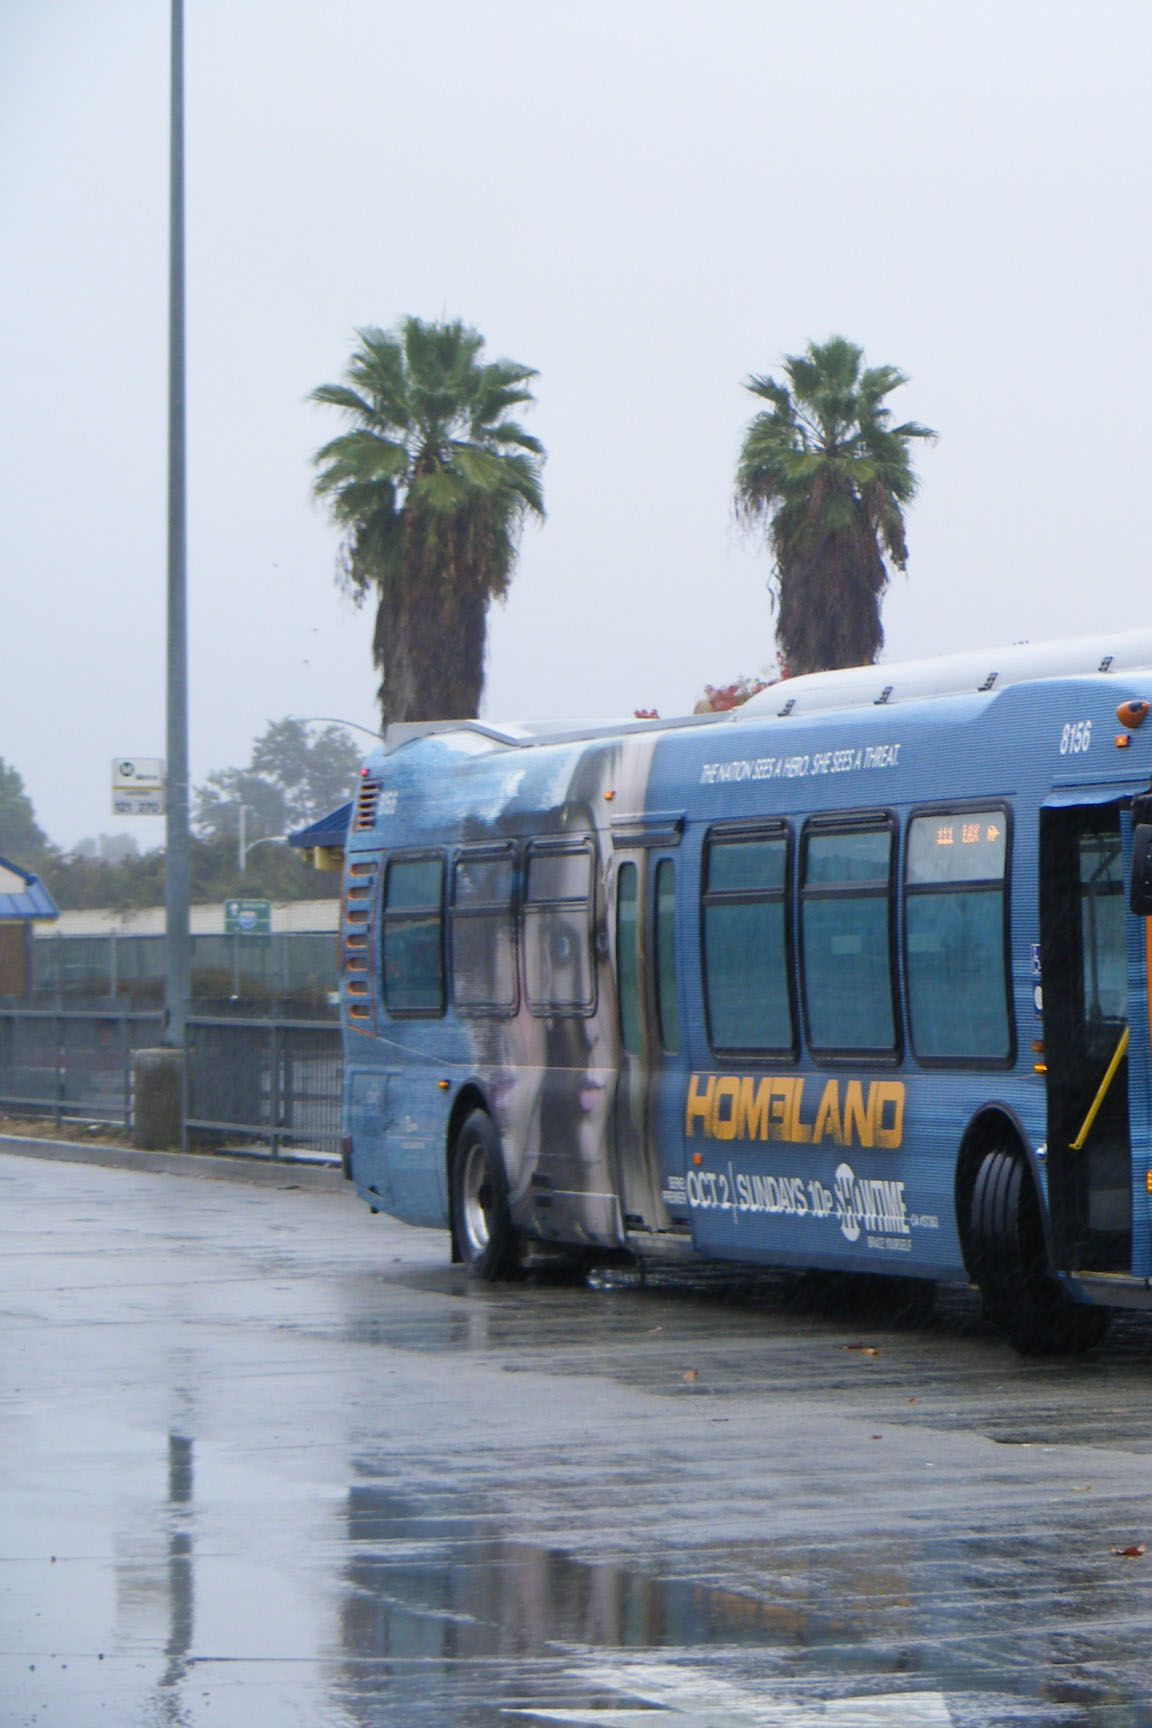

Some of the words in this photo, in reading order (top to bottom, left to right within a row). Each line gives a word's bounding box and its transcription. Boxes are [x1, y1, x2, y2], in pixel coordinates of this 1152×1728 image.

[1060, 720, 1092, 754] 8156
[686, 1075, 905, 1149] HOMELAND
[687, 1170, 716, 1208] OCT
[719, 1174, 733, 1209] 2
[736, 1174, 808, 1216] SUNDAYS
